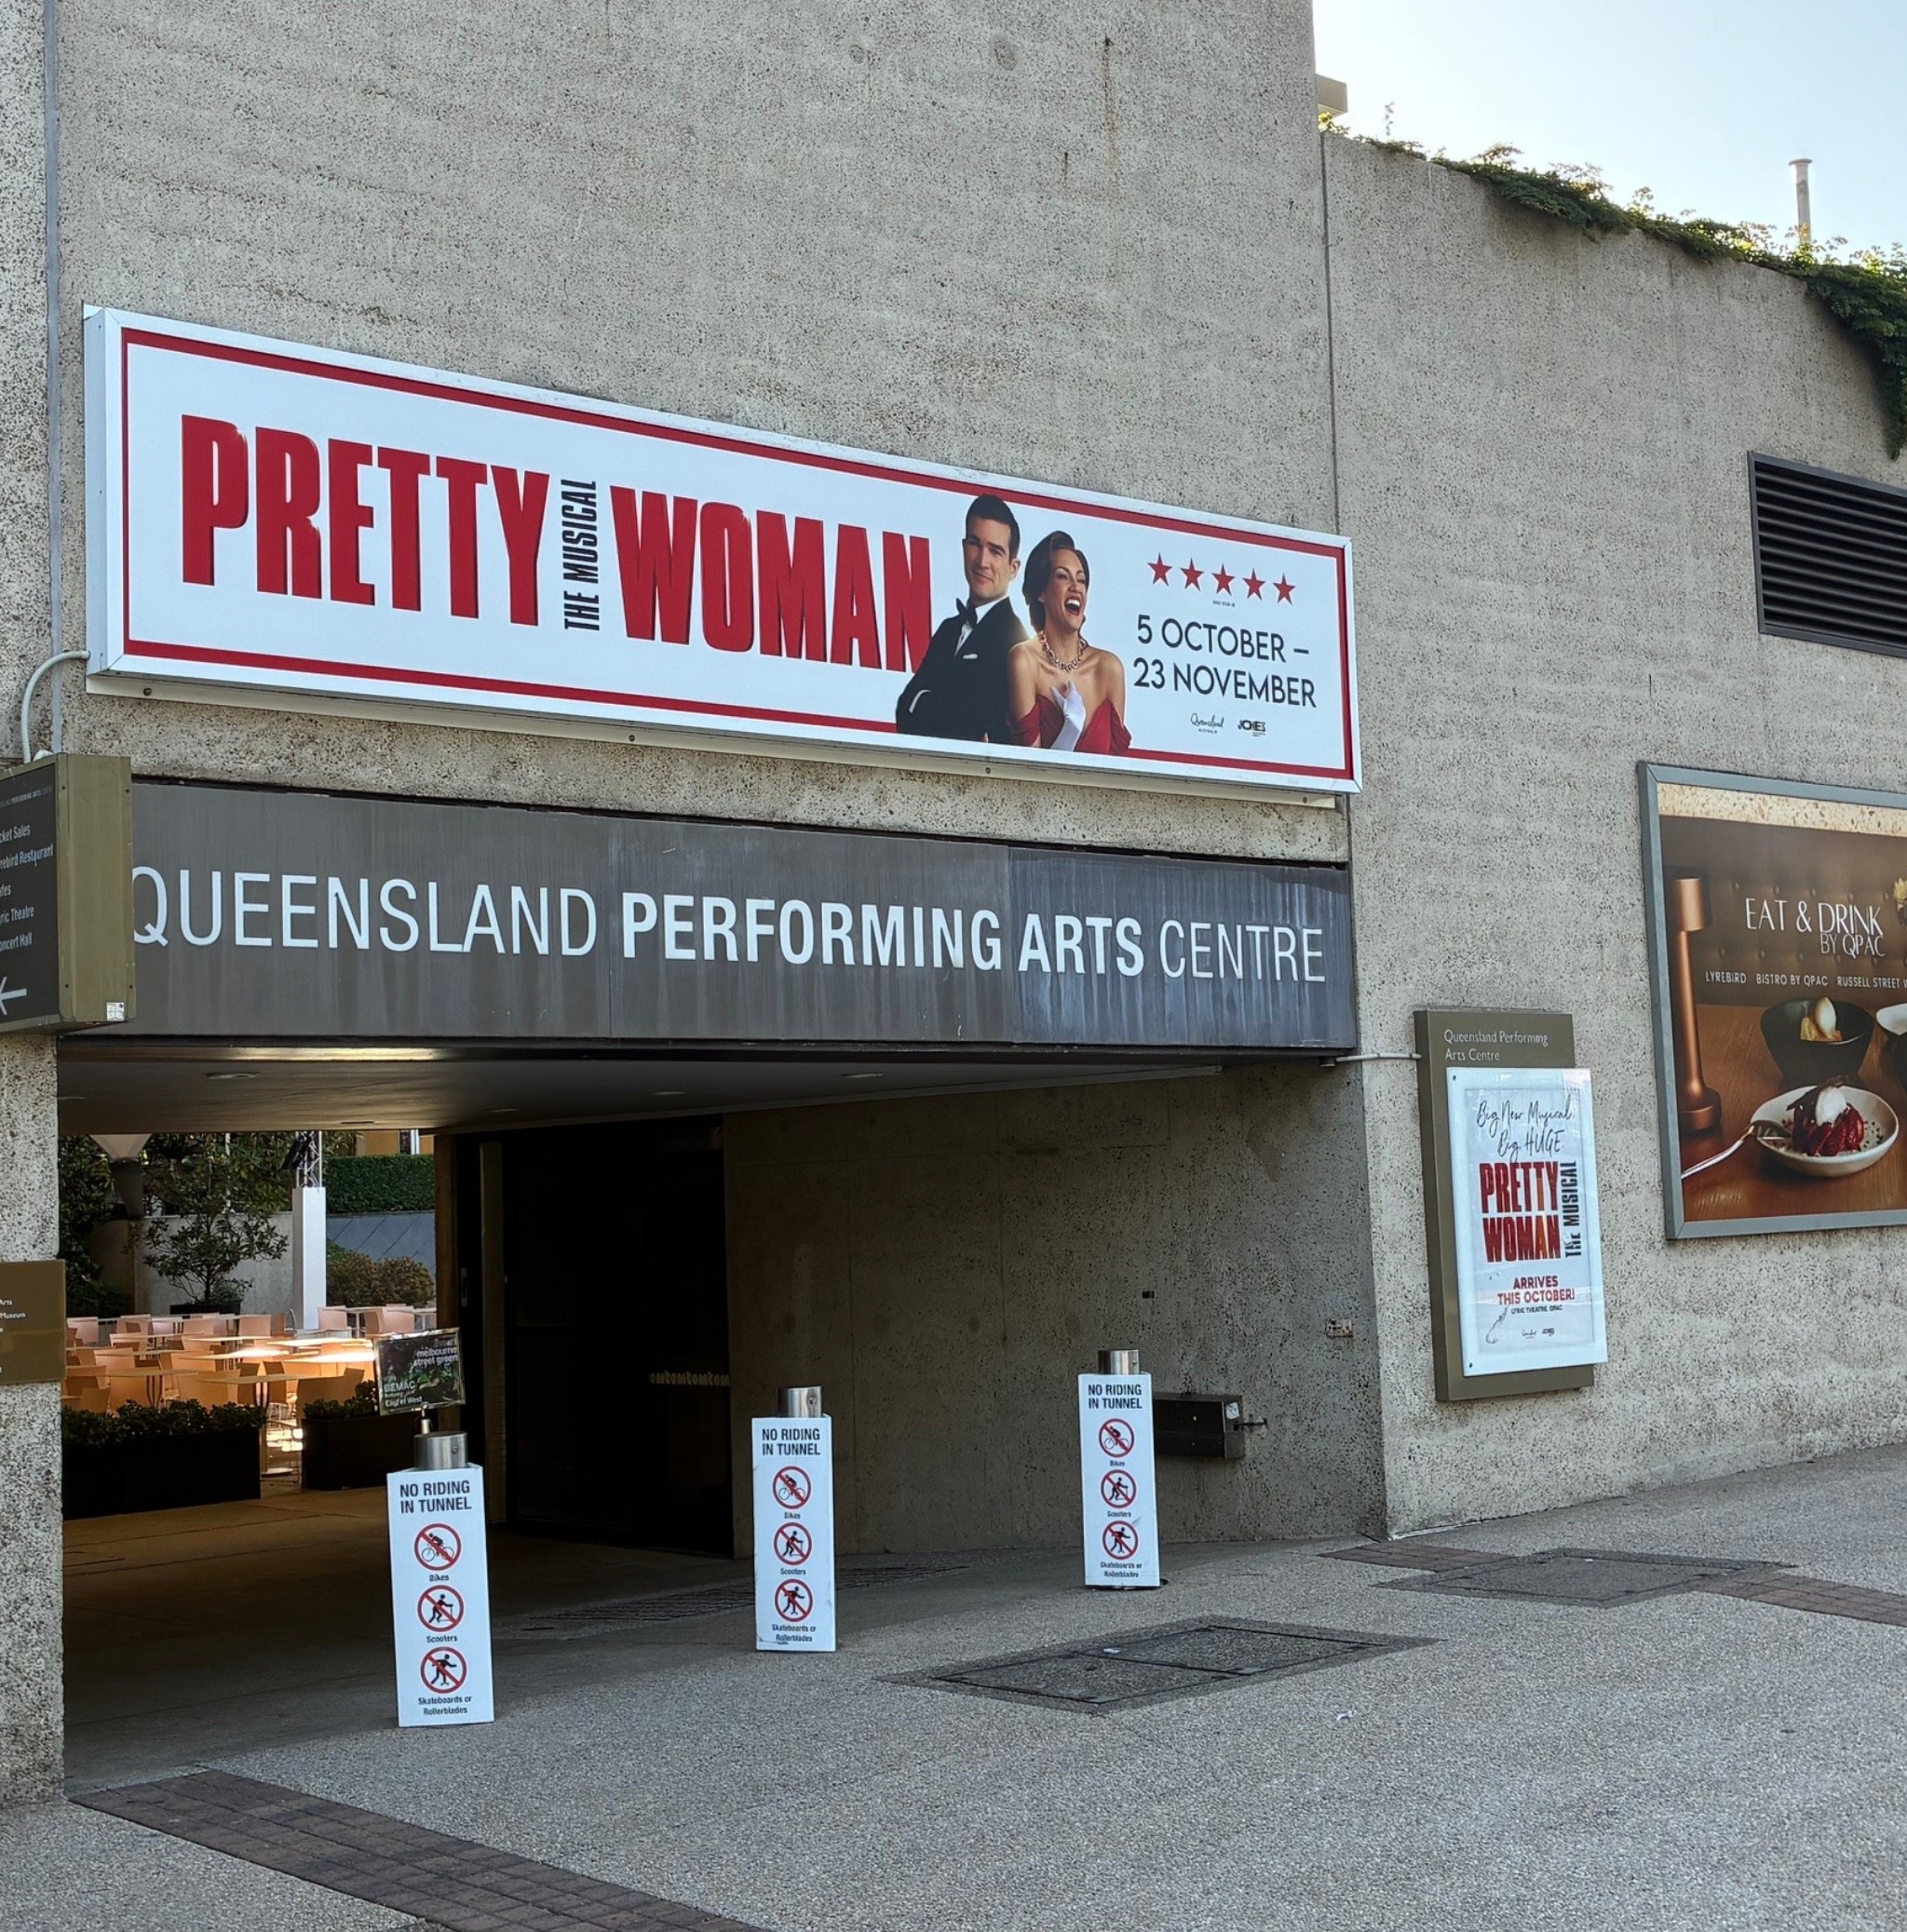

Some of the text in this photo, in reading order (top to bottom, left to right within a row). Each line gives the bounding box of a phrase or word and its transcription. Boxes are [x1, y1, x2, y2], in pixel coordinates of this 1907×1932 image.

[181, 414, 550, 626] PRETTY
[561, 479, 600, 631] THE MUSICAL
[610, 485, 932, 674] WOMAN
[1137, 615, 1153, 643] 5
[1161, 618, 1286, 662] OCTOBER
[1133, 657, 1317, 708] 23 NOVEMBER
[13, 825, 31, 839] Sales
[11, 905, 34, 922] Theatre
[1745, 898, 1884, 936] EAT & DRINK
[132, 866, 1326, 982] QUEENSLAND PERFORMING ARTS CENTRE
[20, 932, 33, 947] Hall
[1820, 932, 1886, 959] BY QPAC
[1705, 971, 1747, 984] LYREBIRD
[1756, 973, 1829, 987] BISTRO BY QPAC
[1837, 976, 1871, 988] RUSSELL
[1873, 978, 1900, 989] STREET
[1443, 1029, 1549, 1047] Queensland Performing
[1445, 1049, 1500, 1061] Arts Centre
[1477, 1100, 1497, 1138] Big
[1502, 1101, 1522, 1128] New
[1479, 1162, 1559, 1213] PRETTY
[1560, 1161, 1581, 1258] THE MUSICAL
[1482, 1215, 1561, 1263] WOMAN
[1513, 1276, 1559, 1290] ARRIVES
[1497, 1289, 1576, 1305] THIS OCTOBER!
[1089, 1384, 1142, 1396] NO RIDING
[1089, 1398, 1143, 1409] IN TUNNEL
[762, 1428, 820, 1441] NO RIDING
[762, 1443, 821, 1456] IN TUNNEL
[399, 1479, 470, 1497] NO RIDING
[400, 1496, 472, 1514] IN TUNNEL
[429, 1574, 450, 1582] Bikes
[772, 1624, 810, 1632] Skateboards
[426, 1634, 458, 1643] Scooters
[776, 1634, 813, 1642] Rollerblades
[418, 1696, 463, 1705] Skateboards
[423, 1707, 467, 1716] Rollerblades
